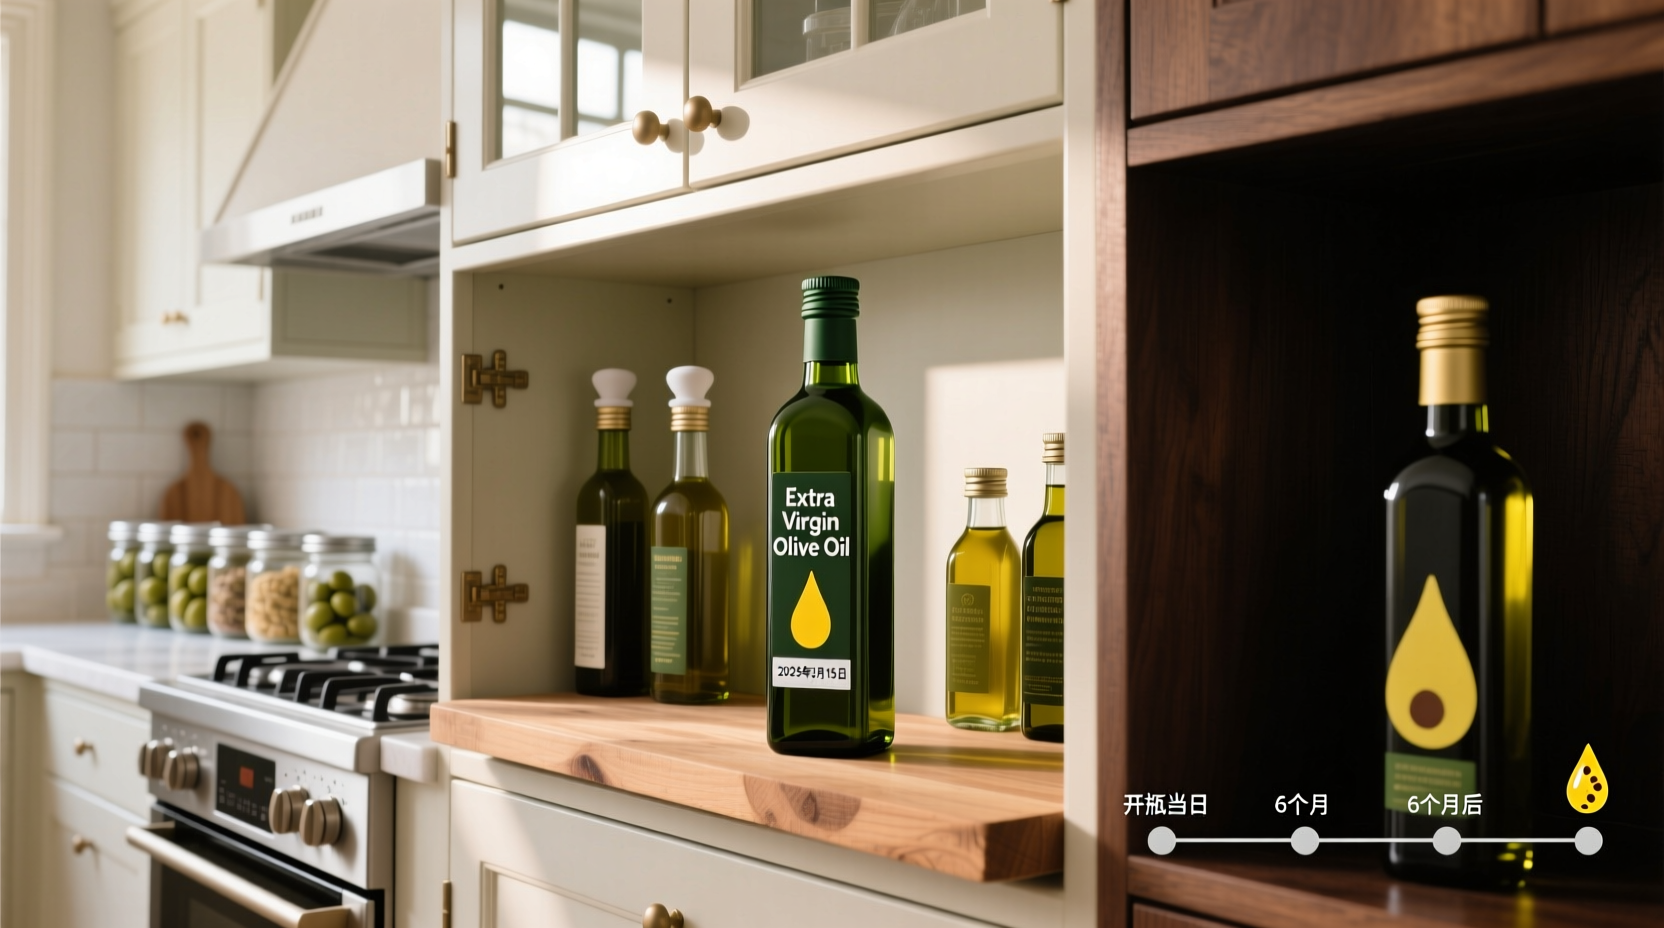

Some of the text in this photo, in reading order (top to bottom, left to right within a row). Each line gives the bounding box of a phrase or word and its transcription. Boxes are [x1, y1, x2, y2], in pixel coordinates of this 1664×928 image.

[785, 487, 835, 507] Extra
[782, 511, 840, 536] Virgin
[773, 536, 850, 557] Olive Oil
